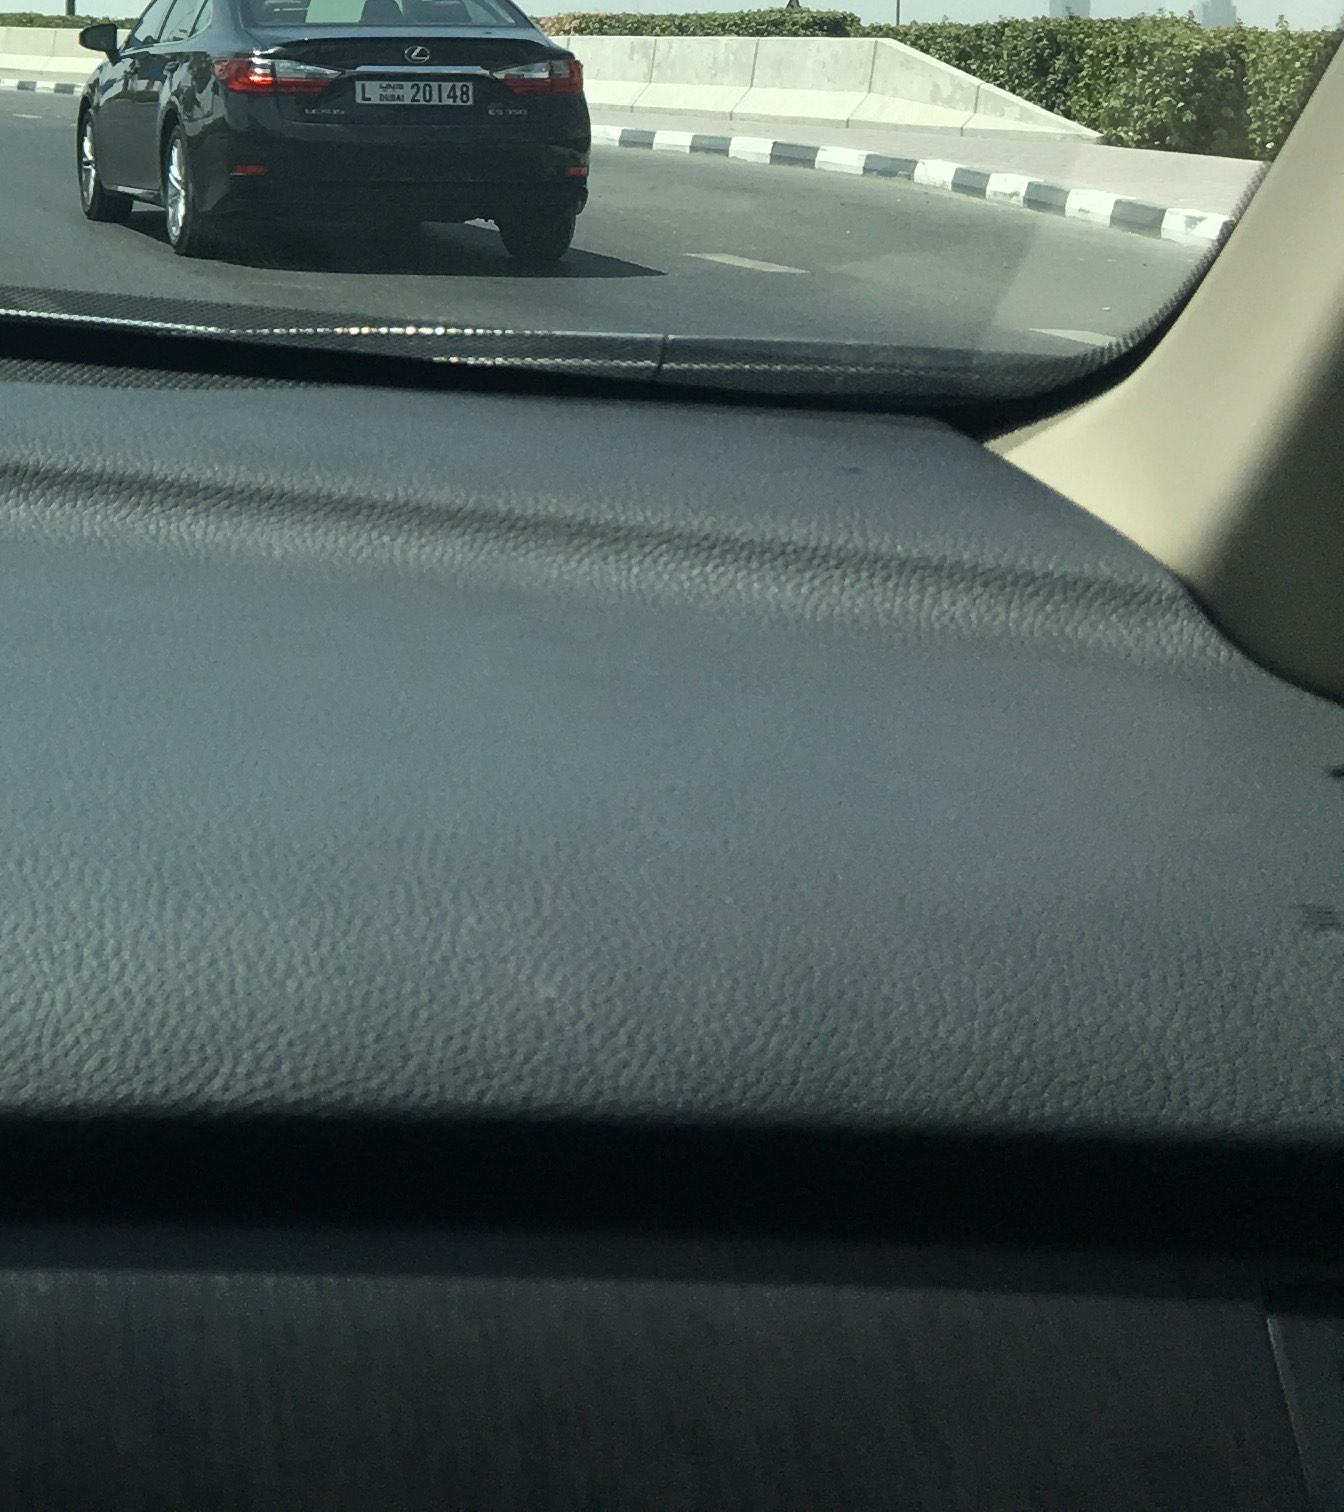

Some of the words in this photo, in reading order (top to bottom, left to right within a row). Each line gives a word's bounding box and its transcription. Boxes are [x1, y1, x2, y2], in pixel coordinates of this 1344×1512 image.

[361, 83, 372, 102] L
[410, 82, 471, 104] 20148
[378, 93, 405, 103] DUBAI
